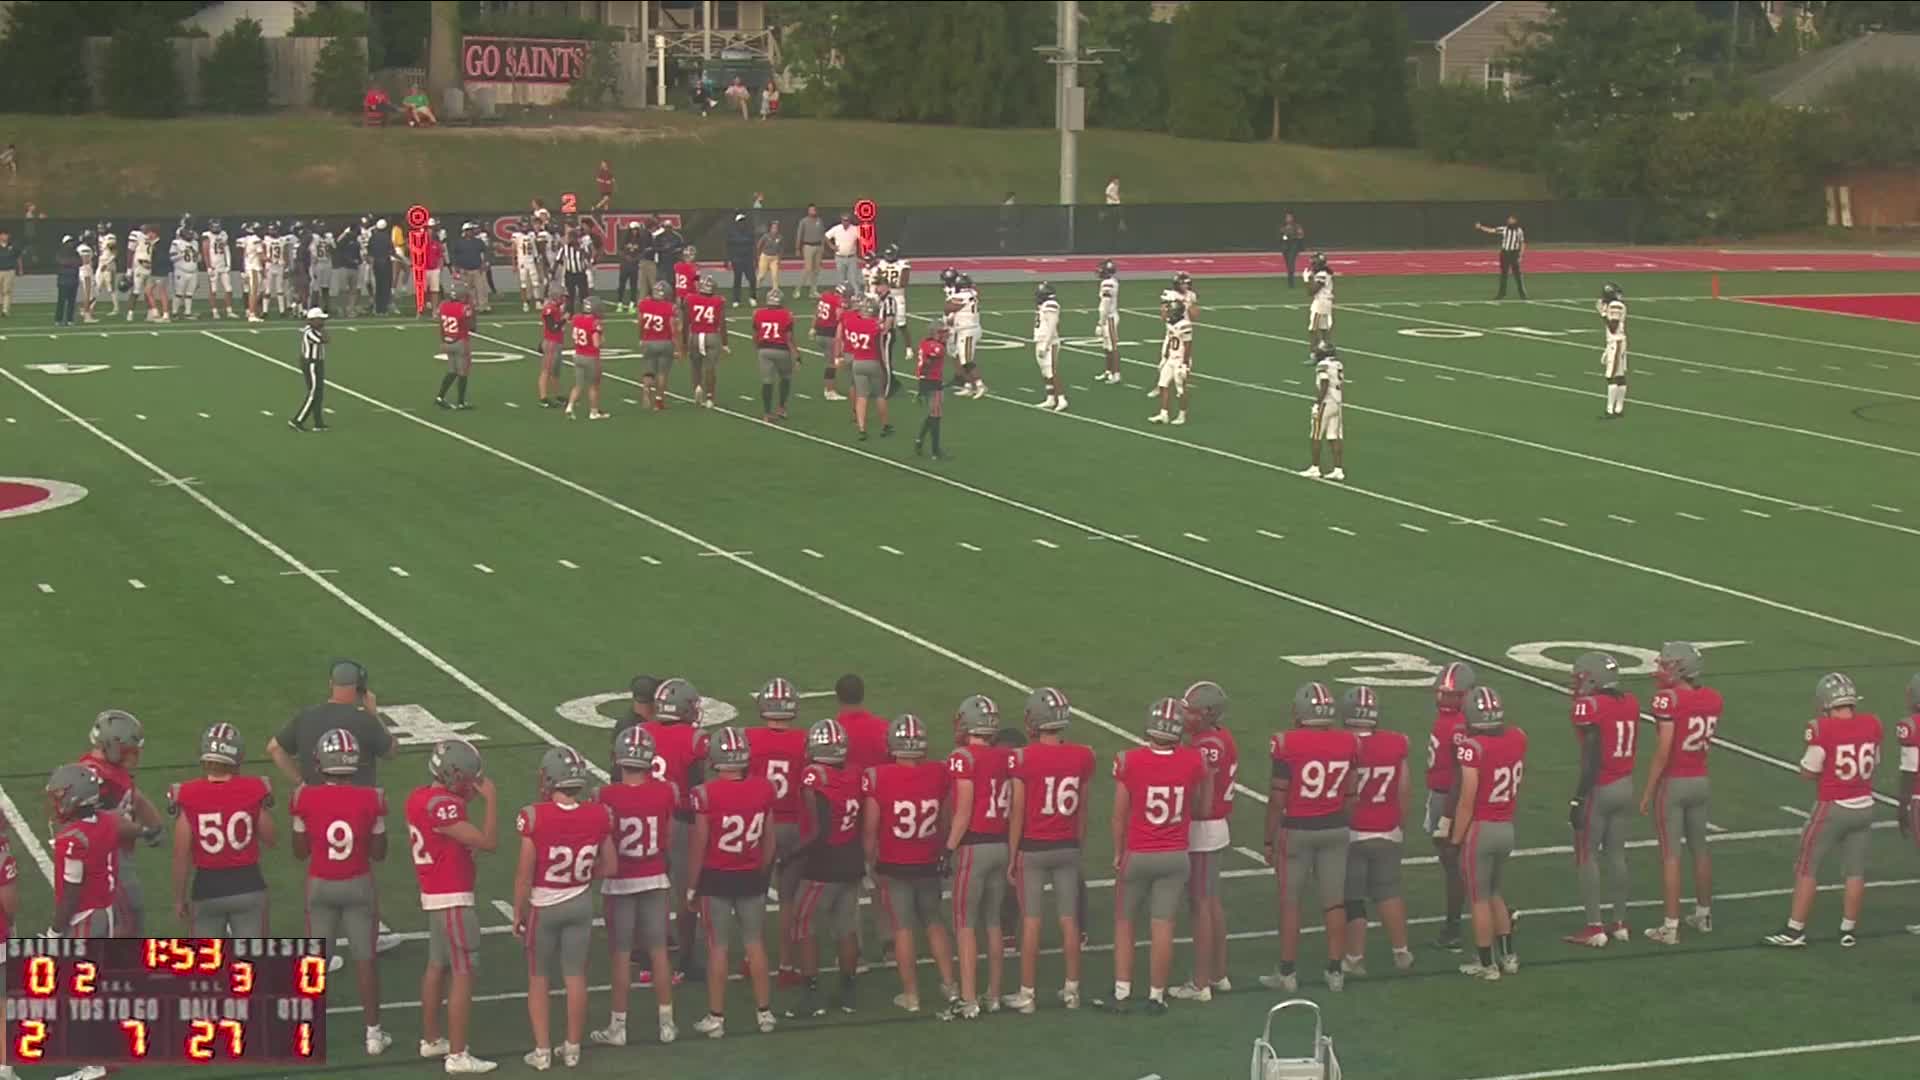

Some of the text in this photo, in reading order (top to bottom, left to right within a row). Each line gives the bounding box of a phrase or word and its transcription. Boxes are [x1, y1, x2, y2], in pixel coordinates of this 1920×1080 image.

[465, 45, 584, 79] GO SAINTS
[561, 193, 577, 213] 2
[643, 313, 664, 332] 73
[693, 305, 715, 323] 74
[761, 322, 780, 339] 71
[1575, 704, 1586, 716] 11
[1613, 720, 1635, 758] 11
[767, 760, 790, 799] 5
[1300, 760, 1350, 799] 97
[1835, 742, 1876, 781] 56
[1041, 776, 1080, 816] 16
[1357, 766, 1396, 803] 77
[436, 805, 458, 820] 42
[892, 799, 940, 839] 32
[1145, 786, 1185, 825] 51
[198, 811, 253, 854] 50
[326, 820, 354, 861] 9
[619, 816, 659, 857] 21
[718, 811, 765, 853] 24
[544, 844, 599, 883] 26
